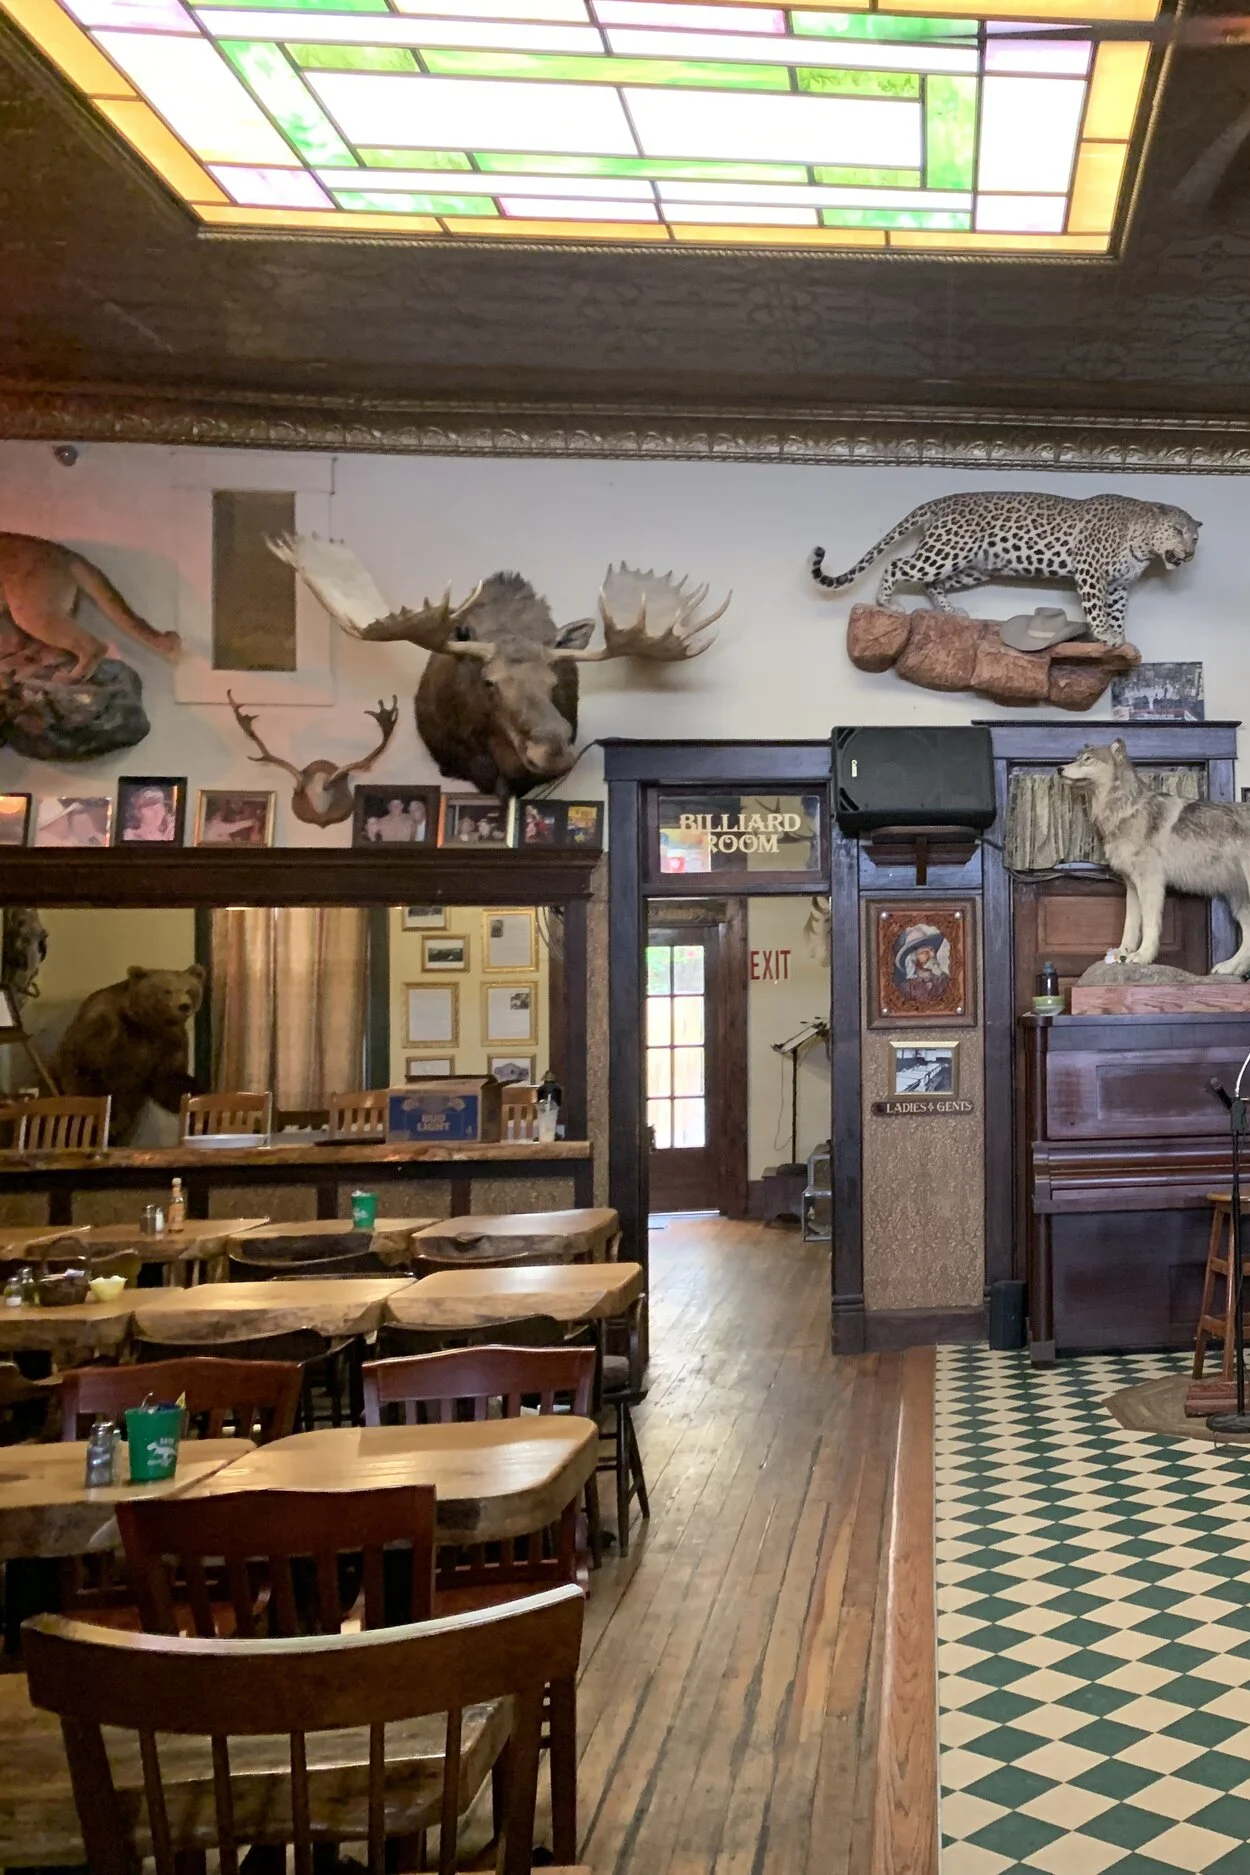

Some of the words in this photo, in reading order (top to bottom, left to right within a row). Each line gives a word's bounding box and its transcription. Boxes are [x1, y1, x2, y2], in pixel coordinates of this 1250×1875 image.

[679, 813, 802, 832] BILLIARD
[706, 834, 780, 854] ROOM
[750, 950, 791, 980] EXIT
[886, 1102, 926, 1113] LADIES
[936, 1101, 973, 1112] GENTS
